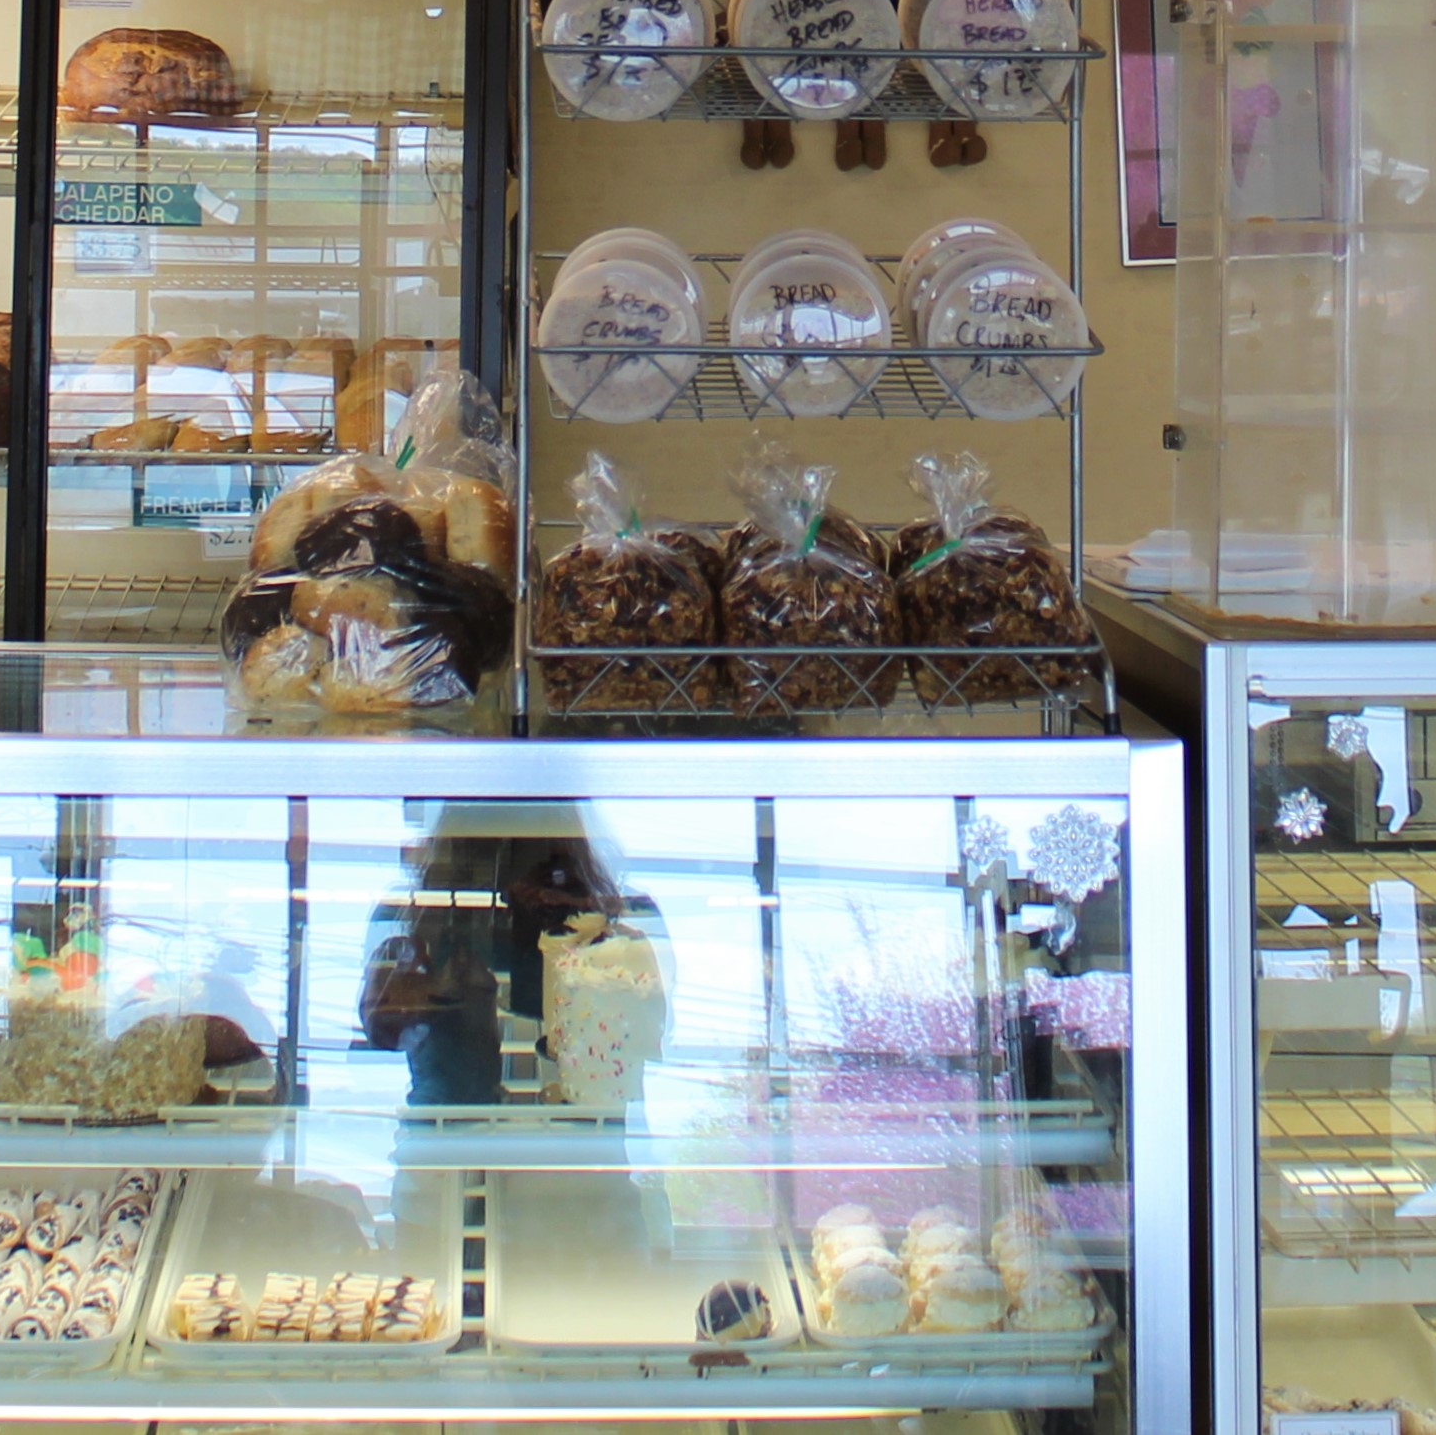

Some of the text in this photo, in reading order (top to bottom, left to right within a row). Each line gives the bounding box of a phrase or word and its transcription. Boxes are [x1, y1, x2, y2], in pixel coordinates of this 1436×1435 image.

[787, 10, 854, 48] BREAD
[961, 23, 1027, 45] BREAD
[54, 185, 173, 203] JALAPENO
[59, 205, 165, 223] CHEDDAR
[598, 285, 670, 322] BREAD
[769, 283, 836, 310] BREAD
[969, 288, 1052, 321] BREAD
[583, 321, 663, 345] CRUMBS
[139, 496, 227, 514] FRENCH
